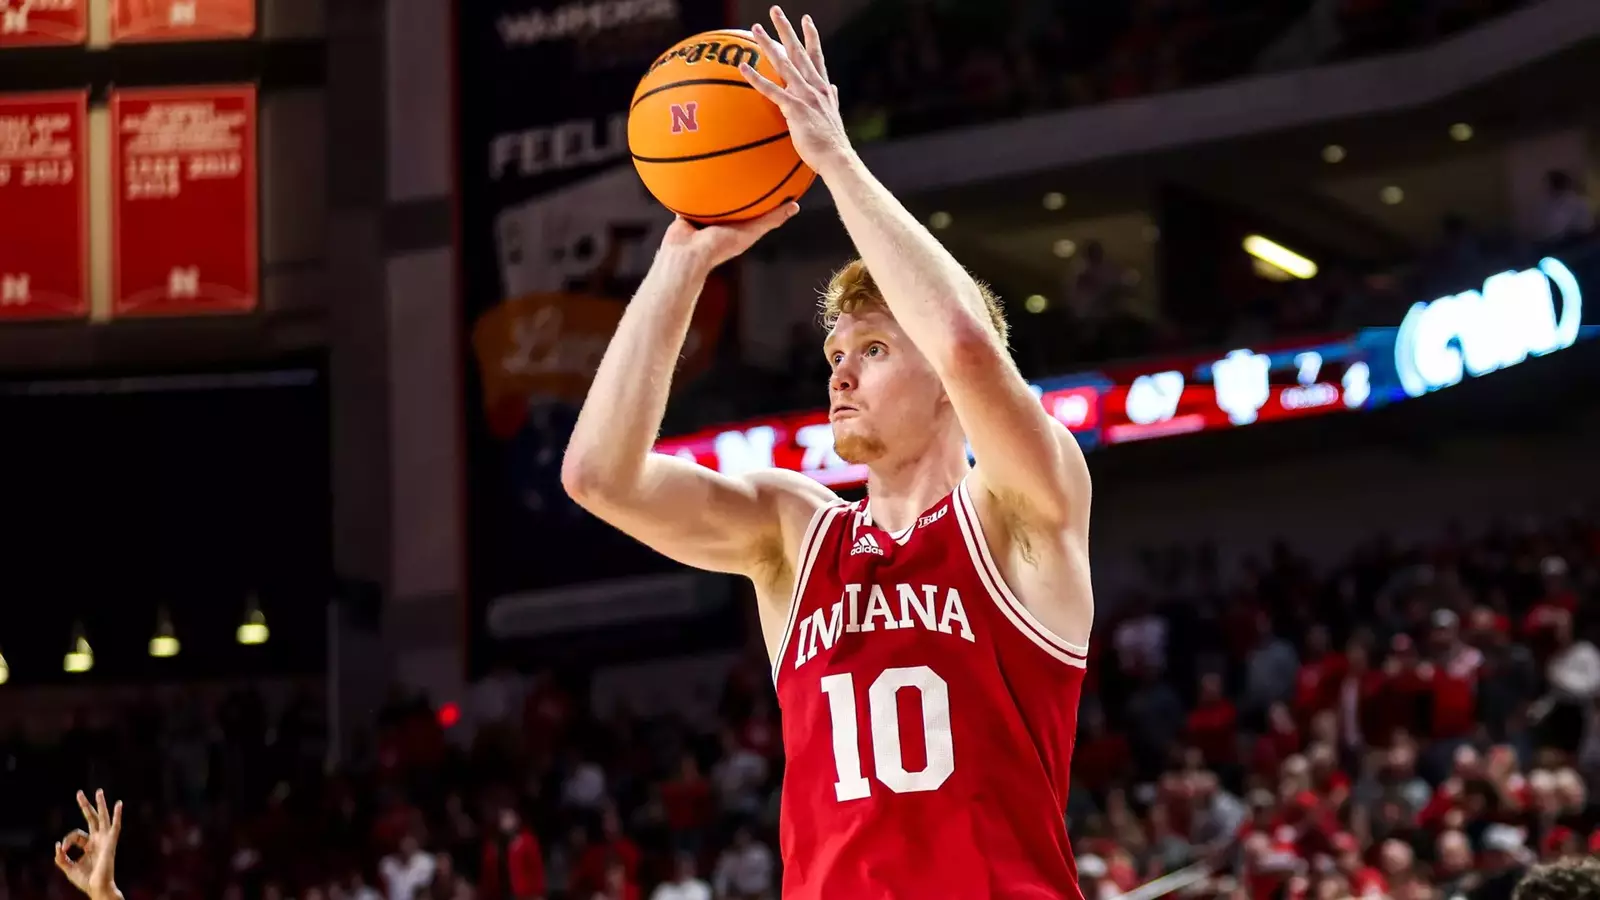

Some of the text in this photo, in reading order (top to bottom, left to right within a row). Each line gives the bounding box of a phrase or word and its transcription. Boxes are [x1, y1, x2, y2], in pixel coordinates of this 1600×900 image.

[670, 101, 700, 134] N
[850, 545, 884, 556] adidas
[820, 665, 955, 803] 10
